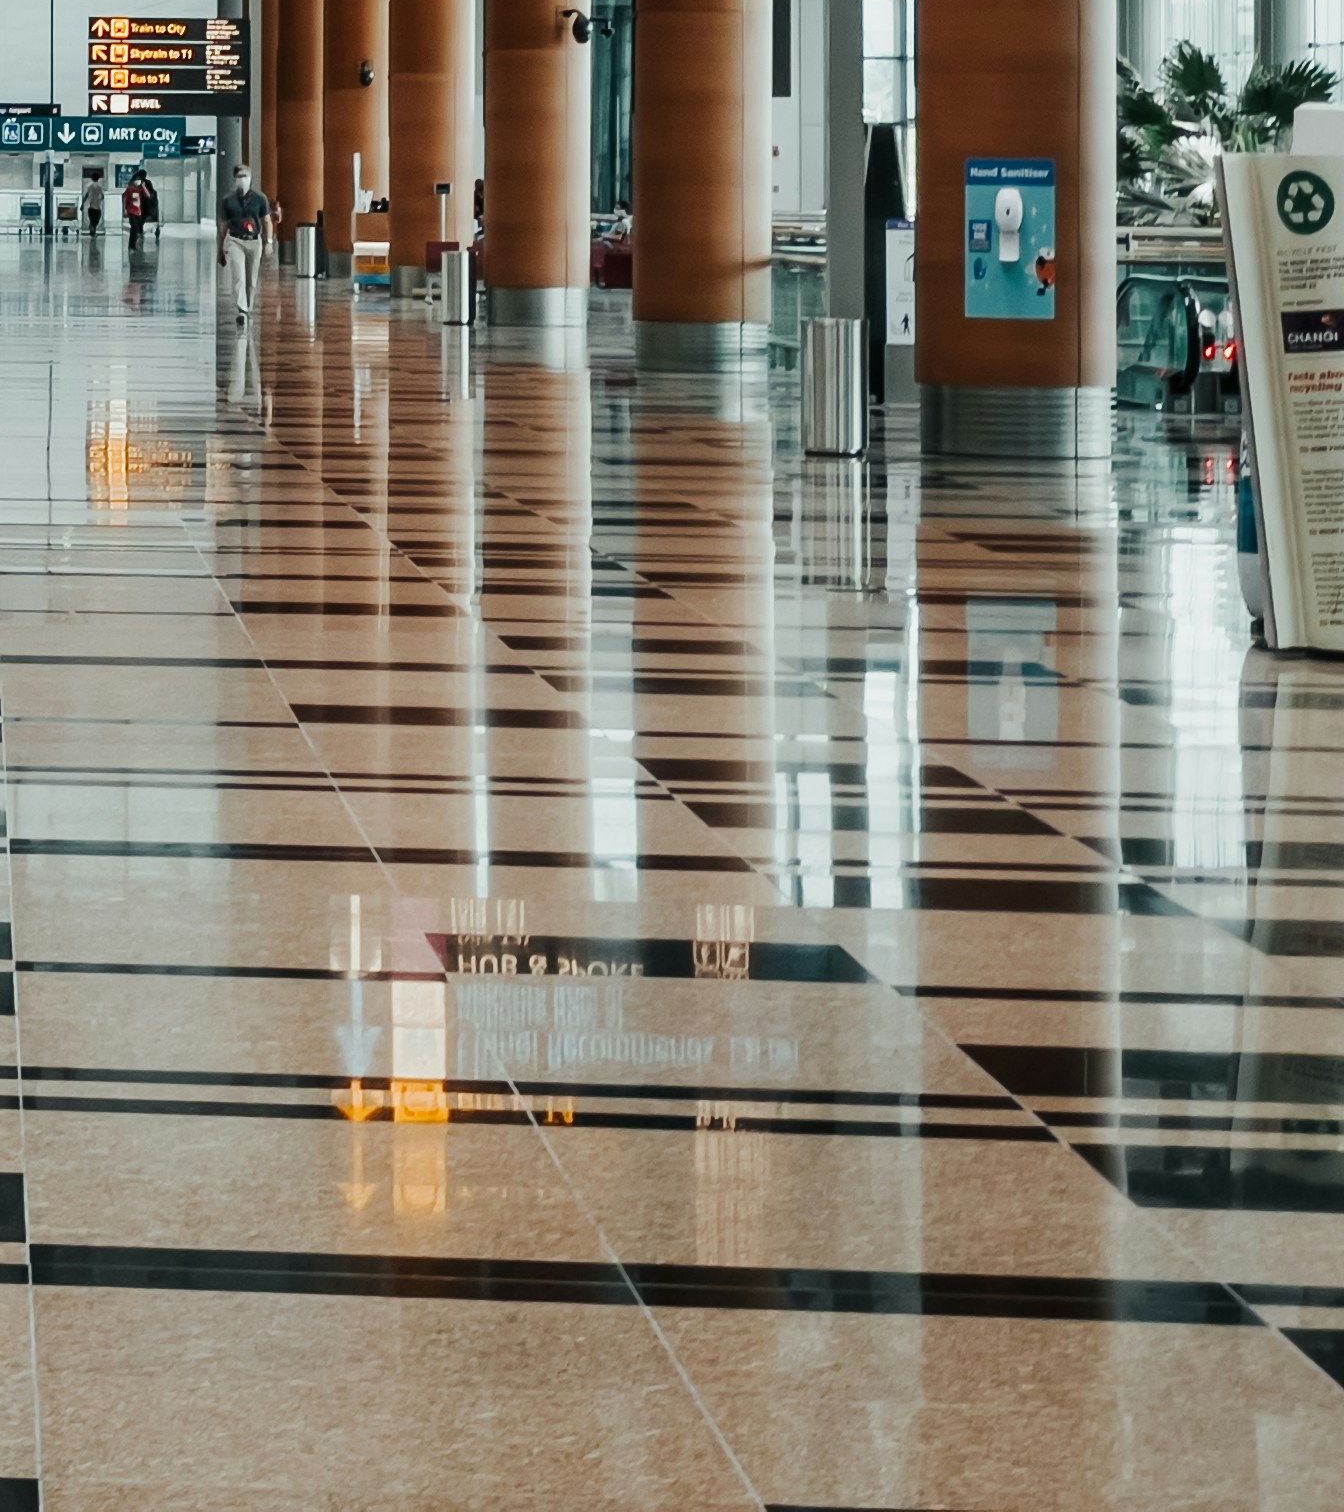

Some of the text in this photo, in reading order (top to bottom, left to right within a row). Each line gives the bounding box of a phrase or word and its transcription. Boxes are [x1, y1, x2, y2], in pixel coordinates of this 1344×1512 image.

[130, 23, 186, 36] Train to City
[130, 49, 192, 61] Skytrain to T1
[130, 74, 170, 84] Bus to T4
[130, 98, 161, 109] JEWEL
[109, 127, 177, 144] MRT to City
[970, 167, 1050, 178] Hand Sanitiser
[1287, 330, 1339, 344] CHANGI
